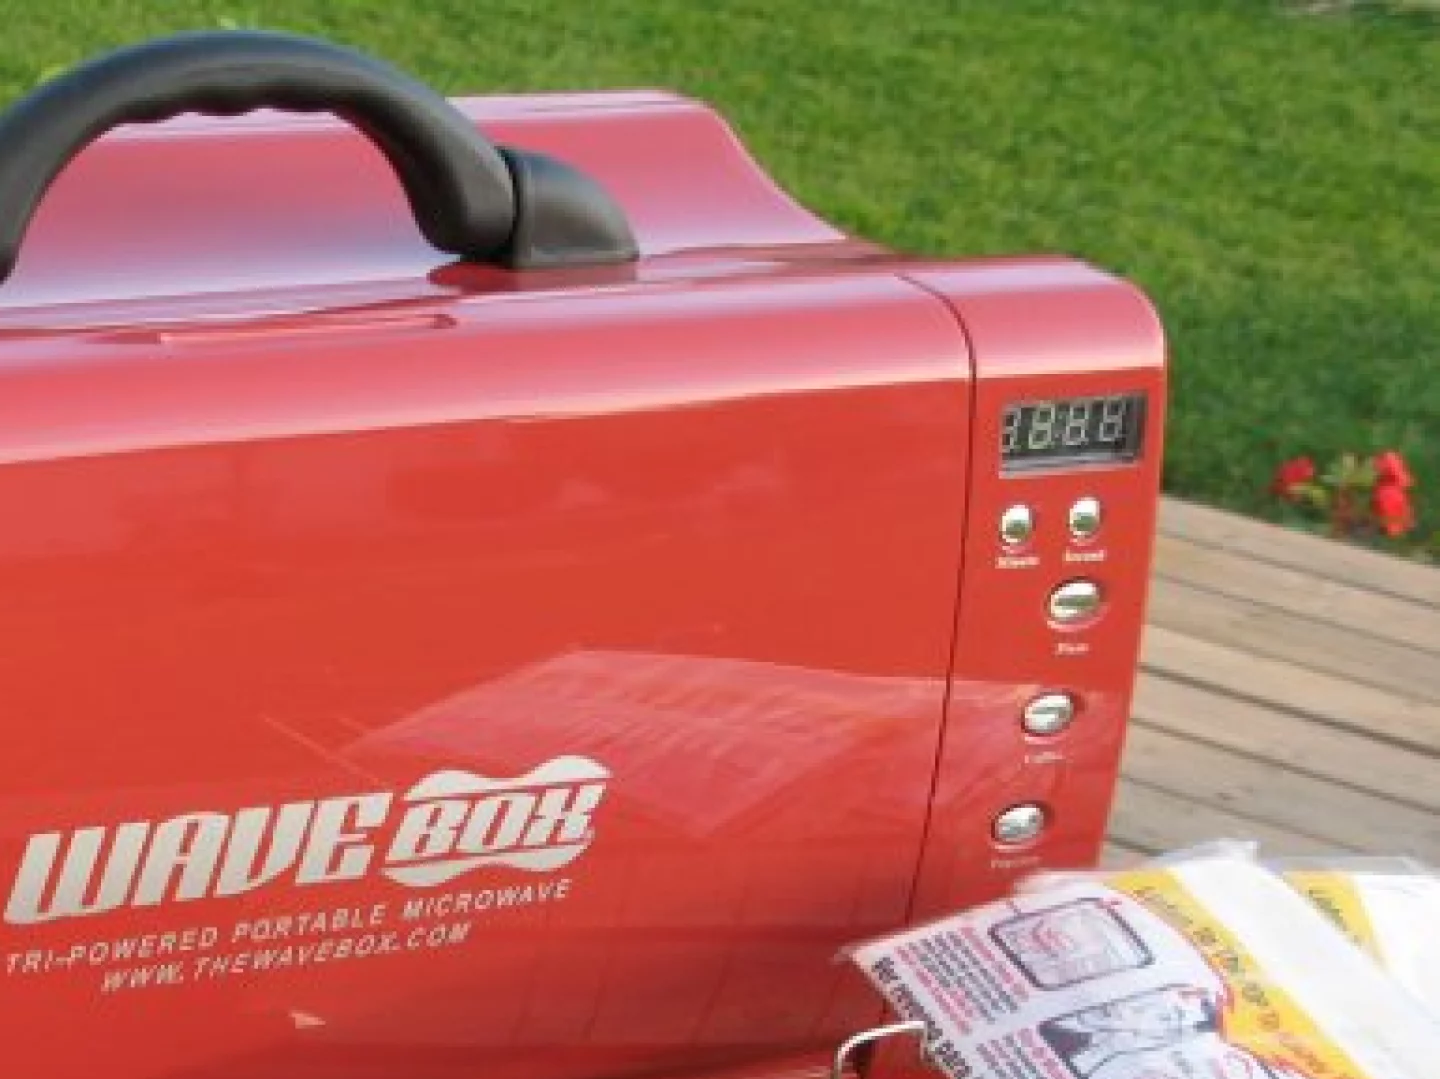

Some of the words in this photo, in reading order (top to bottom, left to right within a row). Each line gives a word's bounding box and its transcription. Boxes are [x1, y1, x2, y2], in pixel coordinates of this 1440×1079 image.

[4, 792, 393, 925] WAVE
[384, 783, 606, 866] BOX
[6, 926, 218, 975] TRI-POWERED
[232, 904, 387, 943] PORTABLE
[402, 878, 572, 920] MICROWAVE
